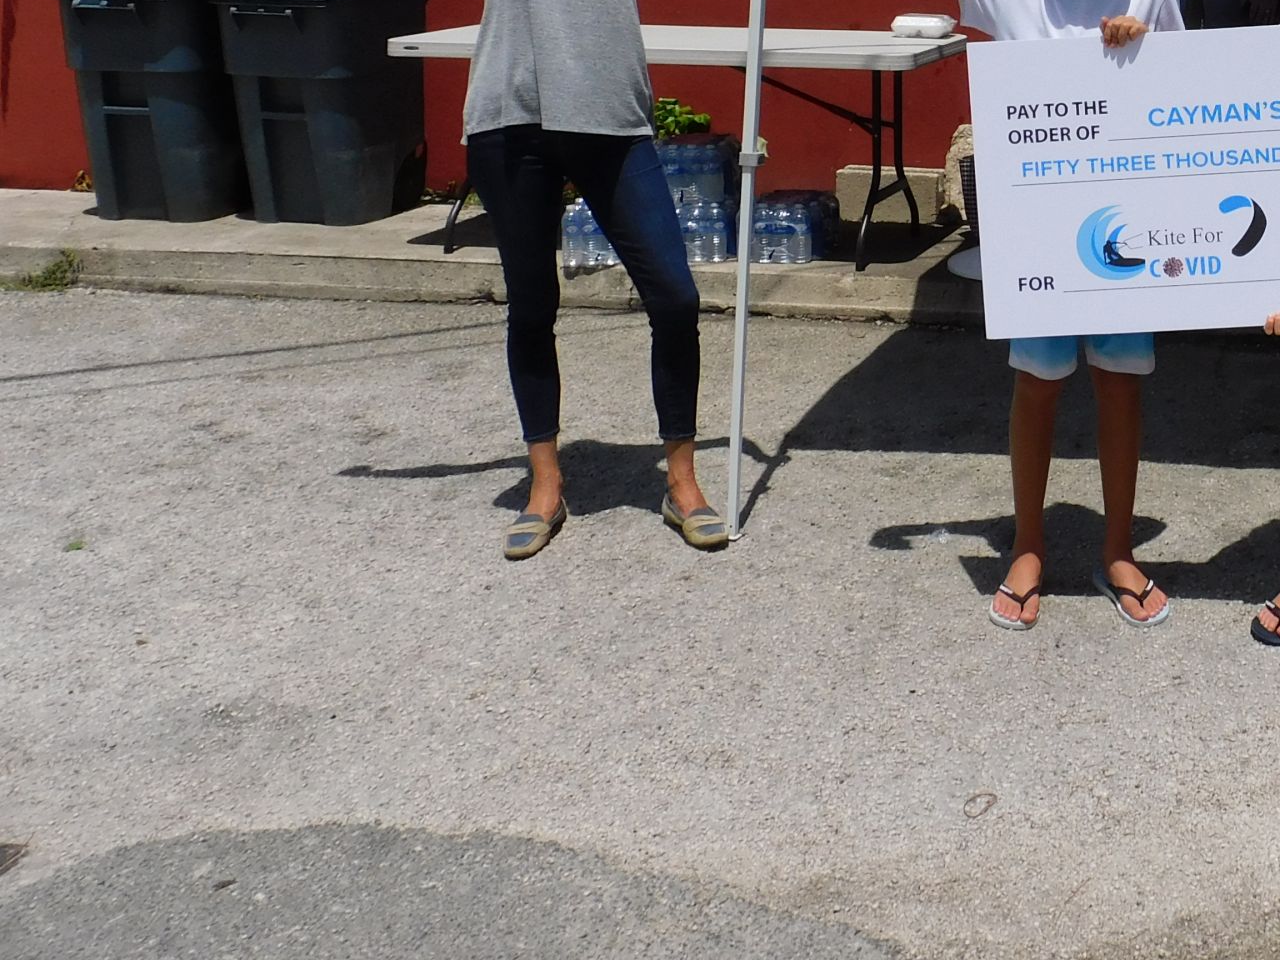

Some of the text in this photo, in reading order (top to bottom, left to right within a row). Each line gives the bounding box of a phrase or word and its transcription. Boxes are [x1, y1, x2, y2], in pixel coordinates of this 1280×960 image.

[1007, 100, 1108, 120] PAY TO THE
[1008, 125, 1101, 145] ORDER OF
[1022, 159, 1080, 178] FIFTY
[1086, 154, 1156, 174] THREE
[1148, 227, 1224, 247] Kite For
[1149, 255, 1222, 278] COVID
[1018, 275, 1055, 292] FOR
